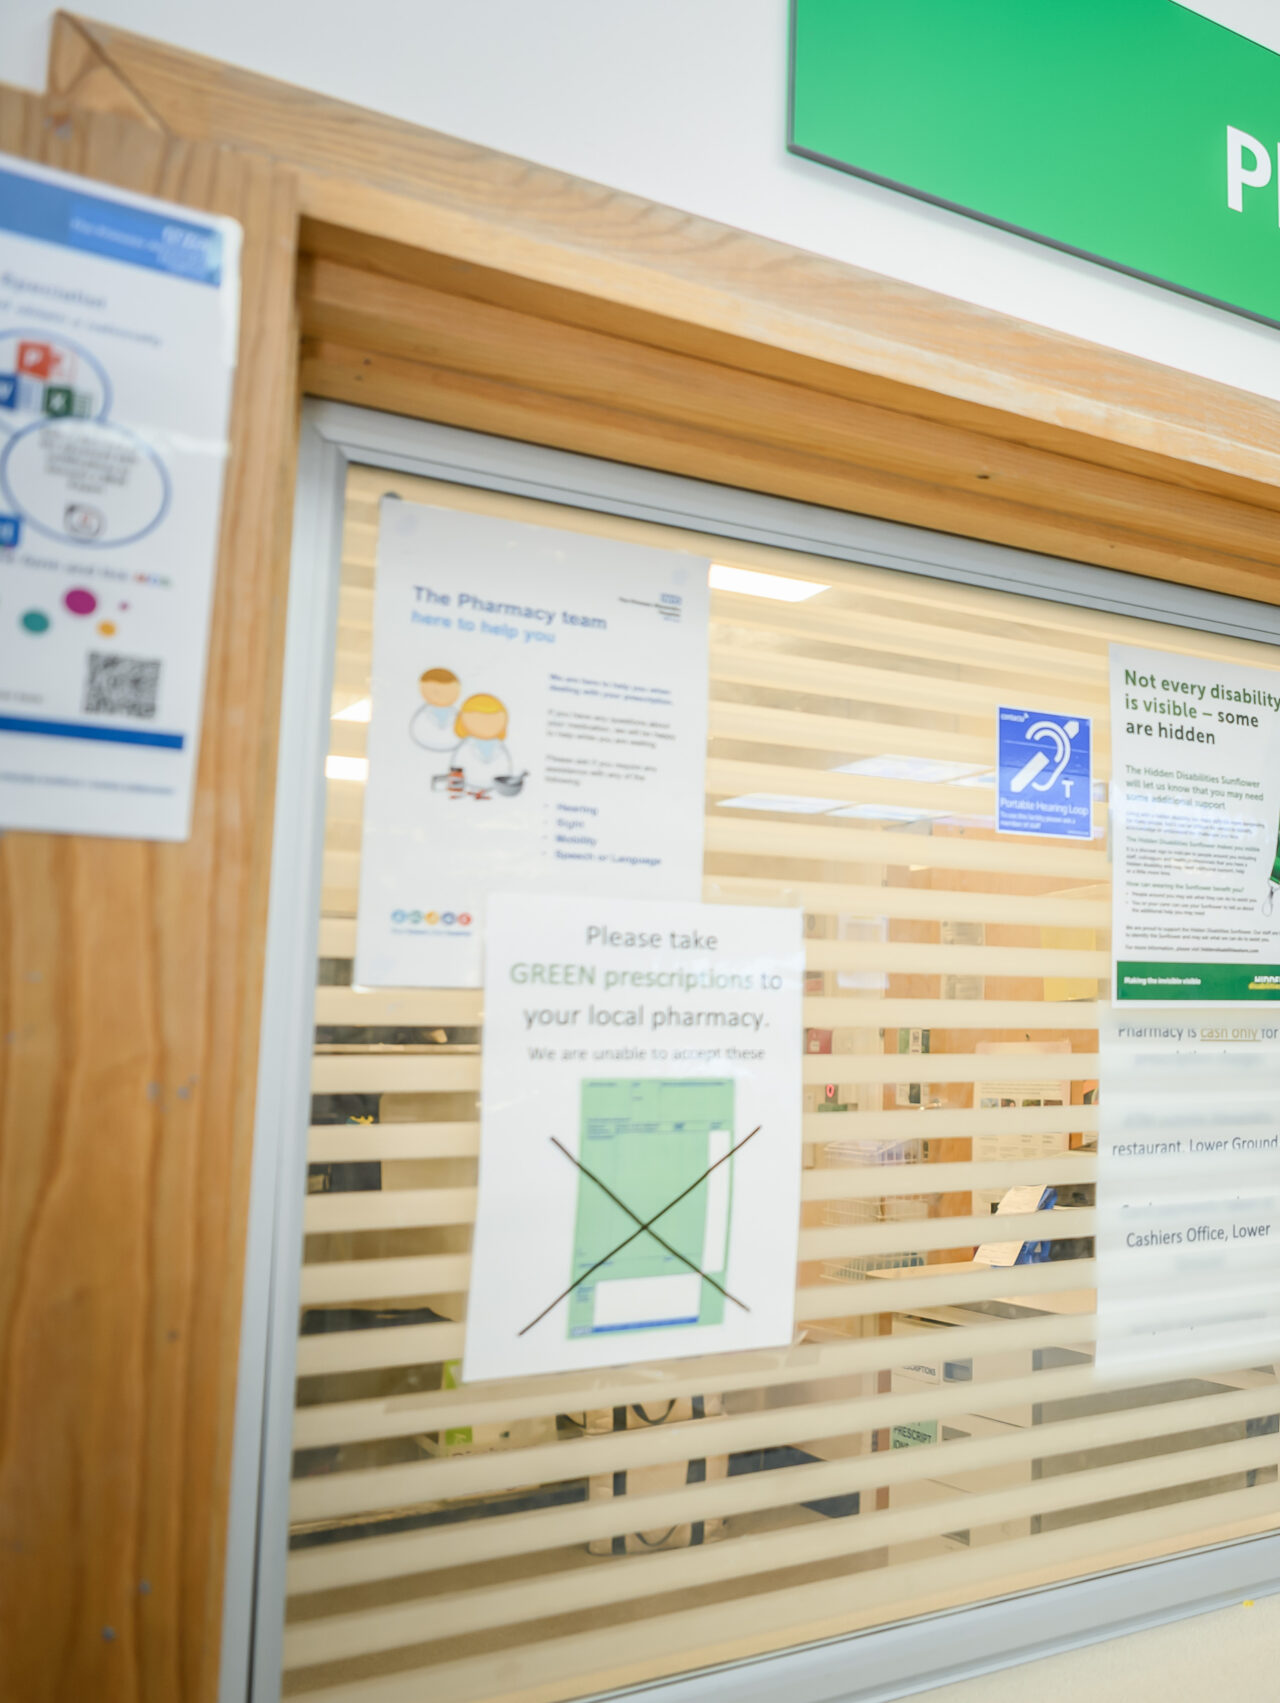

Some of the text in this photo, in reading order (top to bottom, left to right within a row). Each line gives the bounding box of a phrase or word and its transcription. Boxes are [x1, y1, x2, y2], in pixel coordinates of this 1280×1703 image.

[413, 585, 607, 630] The Pharmacy team
[411, 610, 556, 644] here to help you
[1125, 669, 1156, 689] Not
[1161, 678, 1206, 700] every
[1125, 693, 1138, 710] is
[1143, 697, 1197, 718] visible
[1217, 711, 1259, 728] some
[1126, 722, 1216, 745] are hidden
[1126, 764, 1260, 788] The Hidden Disabilities Sunflower
[1126, 779, 1264, 801] will let us know that you may need
[1126, 794, 1226, 810] some additional support
[587, 925, 718, 950] Please take
[509, 962, 783, 991] GREEN prescriptions to
[524, 1004, 770, 1031] your local pharmacy.
[1118, 1026, 1279, 1041] Pharmacy is cash only for
[528, 1046, 766, 1064] We are unable to accept these
[1189, 1138, 1228, 1152] Lower
[1232, 1134, 1278, 1149] Ground
[1126, 1224, 1271, 1248] Cashiers Office, Lower
